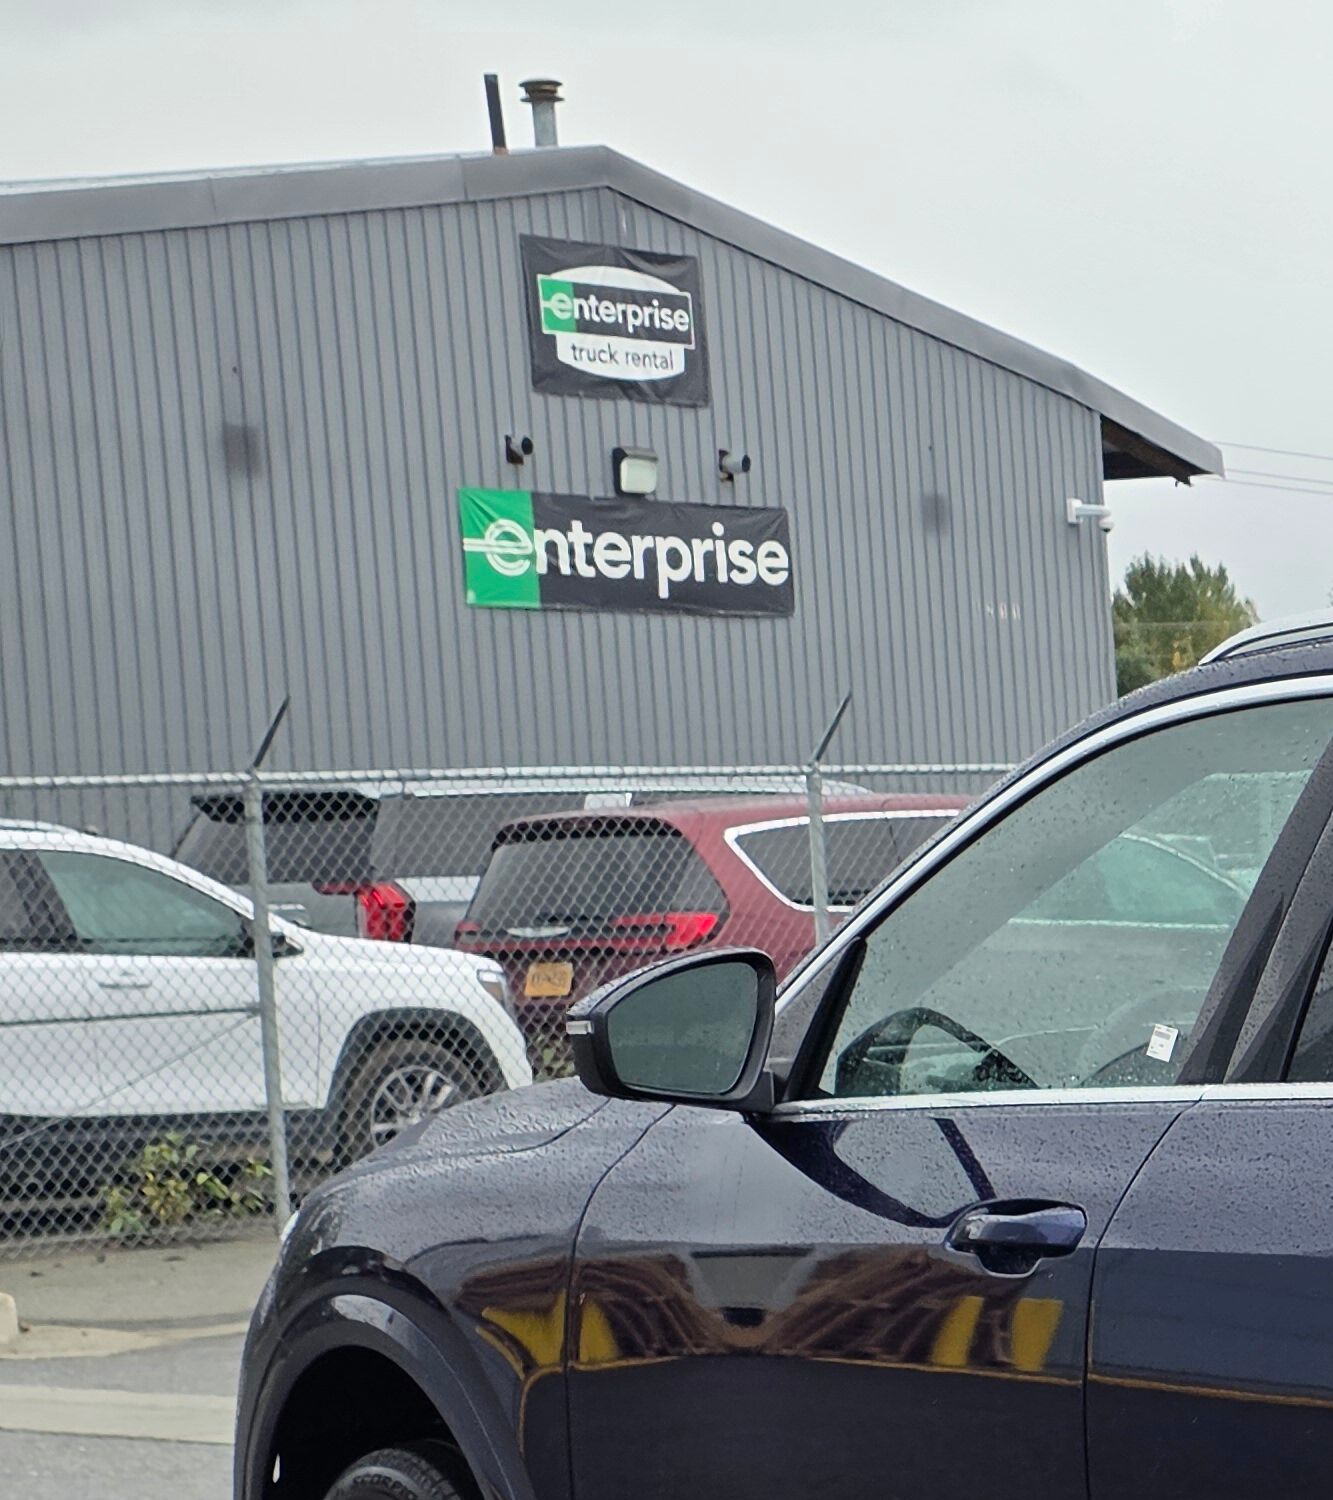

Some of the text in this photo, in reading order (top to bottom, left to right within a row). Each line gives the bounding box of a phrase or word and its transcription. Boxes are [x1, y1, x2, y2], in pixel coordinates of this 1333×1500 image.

[540, 290, 690, 333] enterprise
[571, 342, 674, 371] truck rental
[463, 517, 790, 600] enterprise
